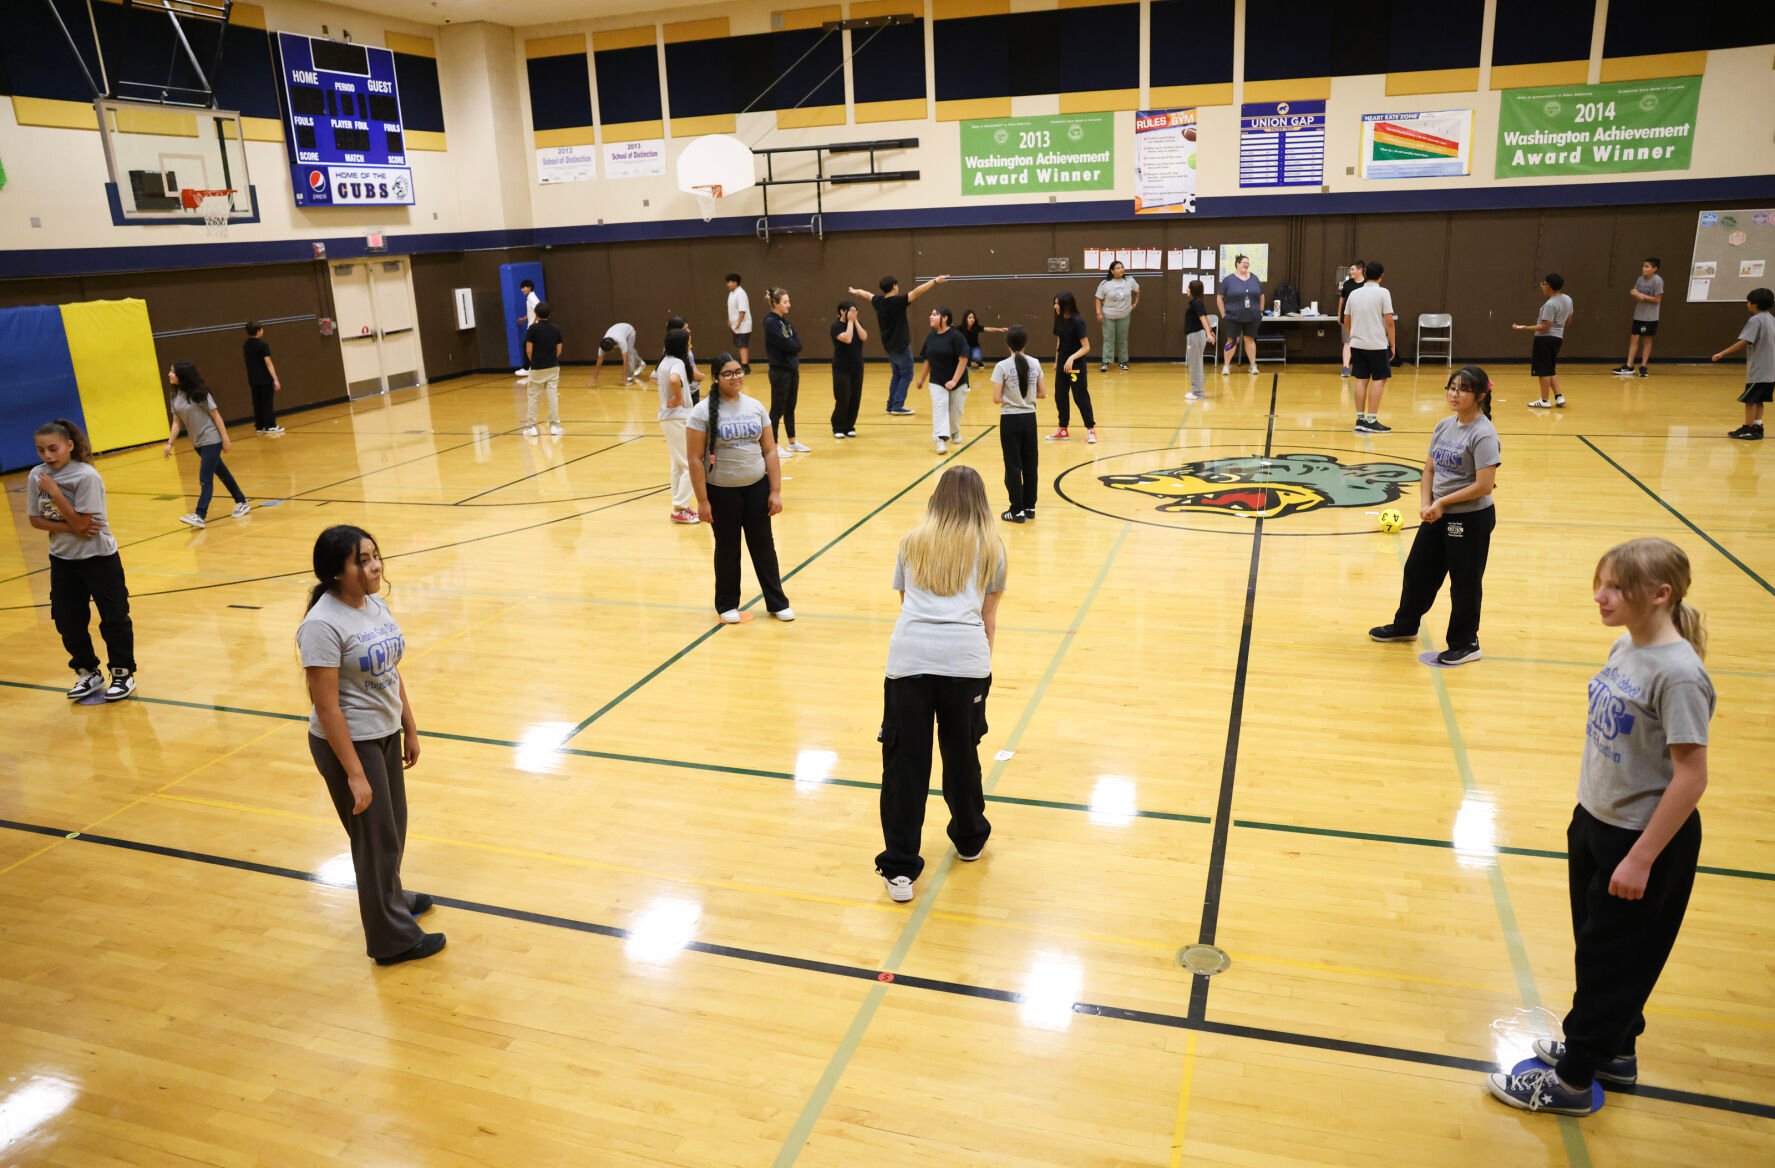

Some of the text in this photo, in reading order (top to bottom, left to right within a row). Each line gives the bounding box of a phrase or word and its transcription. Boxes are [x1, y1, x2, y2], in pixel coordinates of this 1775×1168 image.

[292, 70, 319, 85] HOME
[334, 82, 356, 93] PERIOD
[367, 79, 393, 94] GUEST
[1574, 102, 1616, 123] 2014
[294, 116, 314, 126] FOULS
[331, 119, 369, 130] PLAYER FOUL
[1136, 113, 1194, 130] RULES GYM
[1251, 116, 1315, 128] UNION GAP
[383, 123, 401, 133] FOULS
[1019, 130, 1051, 149] 2013
[1504, 123, 1690, 147] Washington Achievement
[299, 152, 319, 161] SCORE
[344, 153, 365, 163] MATCH
[388, 155, 405, 164] SCORE
[612, 152, 627, 160] School
[965, 151, 1110, 169] Washington Achievement
[1511, 144, 1675, 166] Award Winner
[335, 171, 359, 179] HOME
[974, 168, 1101, 186] Award Winner
[337, 182, 389, 199] CUBS
[721, 422, 760, 441] CUBS
[1381, 512, 1388, 521] 3
[1393, 513, 1399, 522] 4
[1386, 524, 1392, 532] 7
